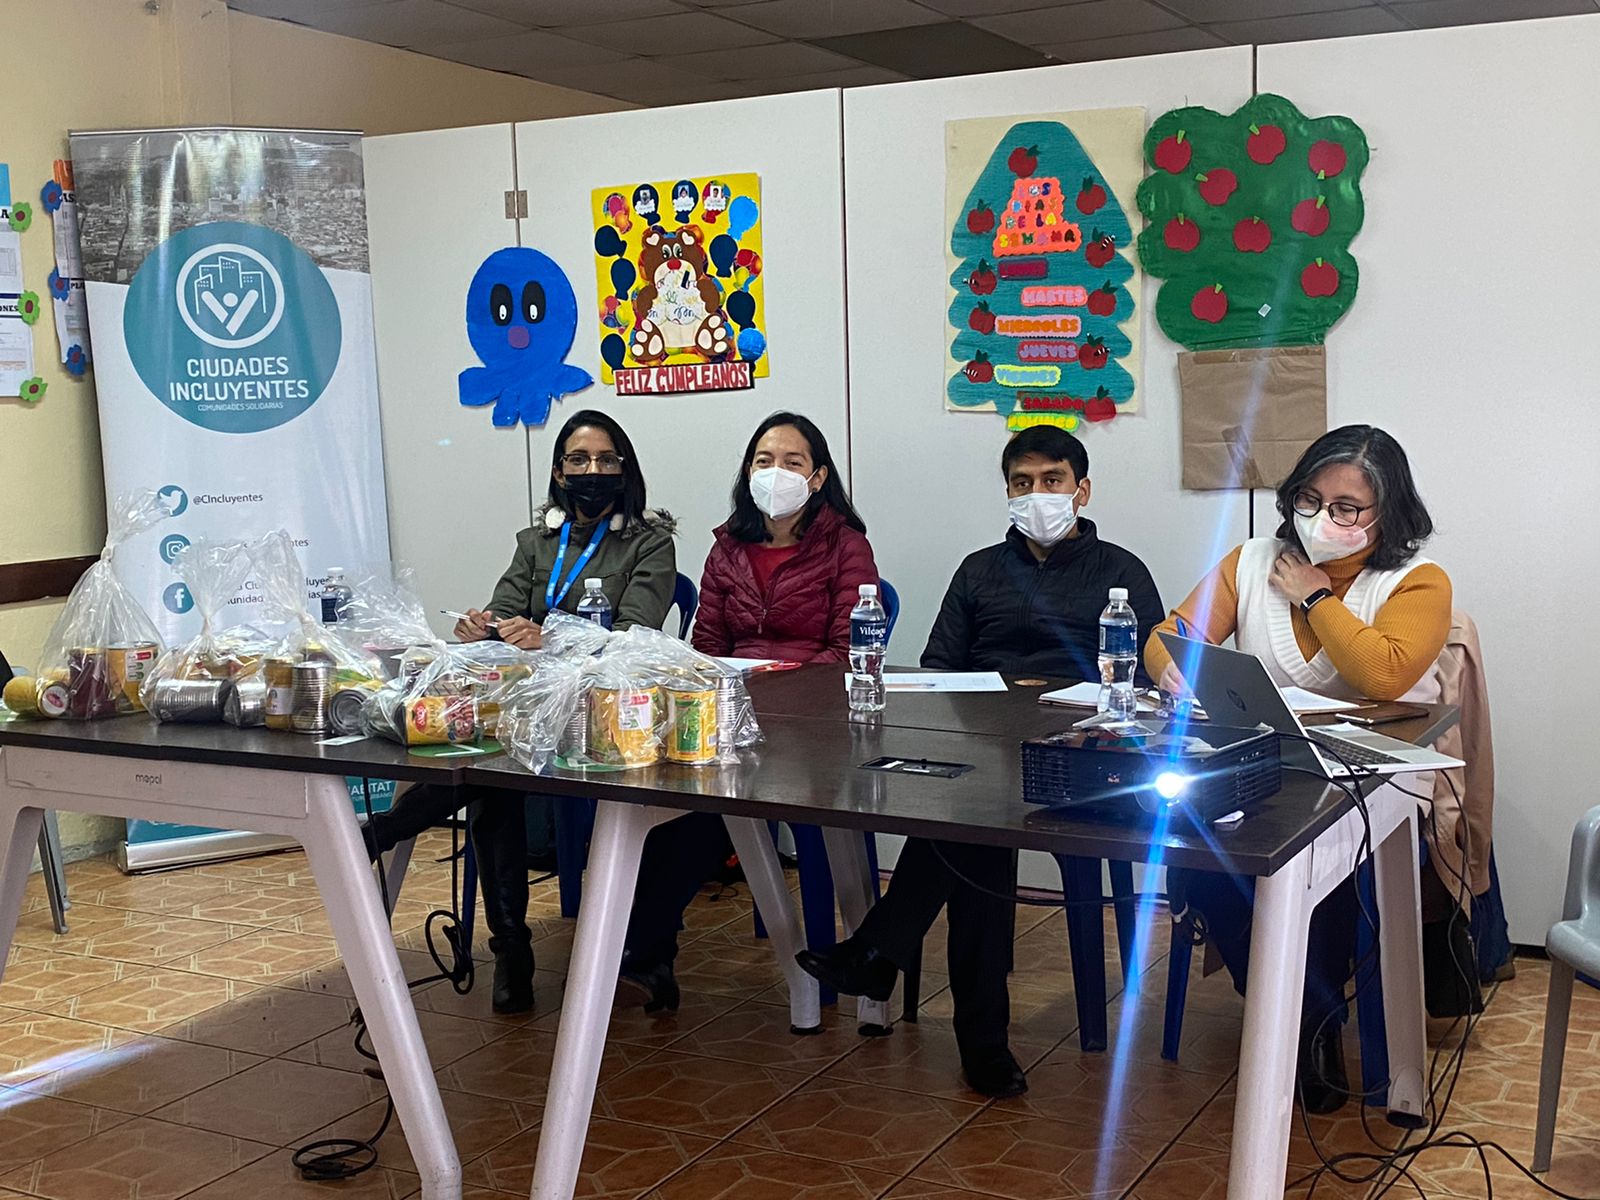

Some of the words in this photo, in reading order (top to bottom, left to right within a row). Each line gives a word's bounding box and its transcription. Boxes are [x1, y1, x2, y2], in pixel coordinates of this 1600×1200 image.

[1020, 345, 1077, 358] JUEVES
[186, 356, 289, 378] CIUDADES
[169, 379, 309, 401] INCLUYENTES
[615, 369, 653, 393] FELIZ
[193, 494, 263, 505] @CIncluyentes
